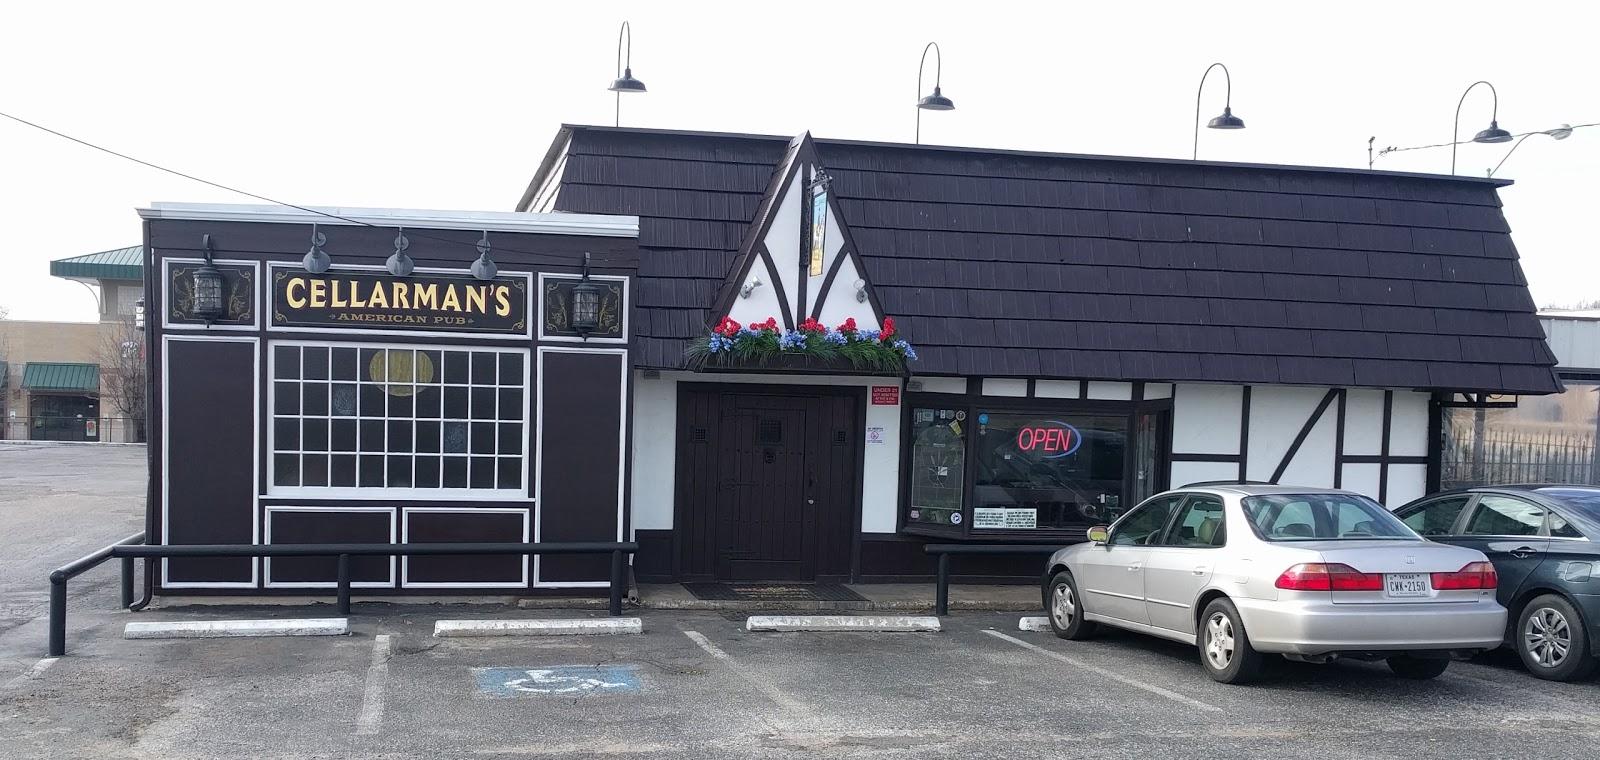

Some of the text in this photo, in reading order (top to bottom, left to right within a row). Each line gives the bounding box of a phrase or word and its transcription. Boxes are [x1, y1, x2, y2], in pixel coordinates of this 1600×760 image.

[286, 277, 511, 317] CELLARMAN'S
[338, 313, 466, 325] AMERICAN PUB
[1018, 427, 1072, 452] OPEN
